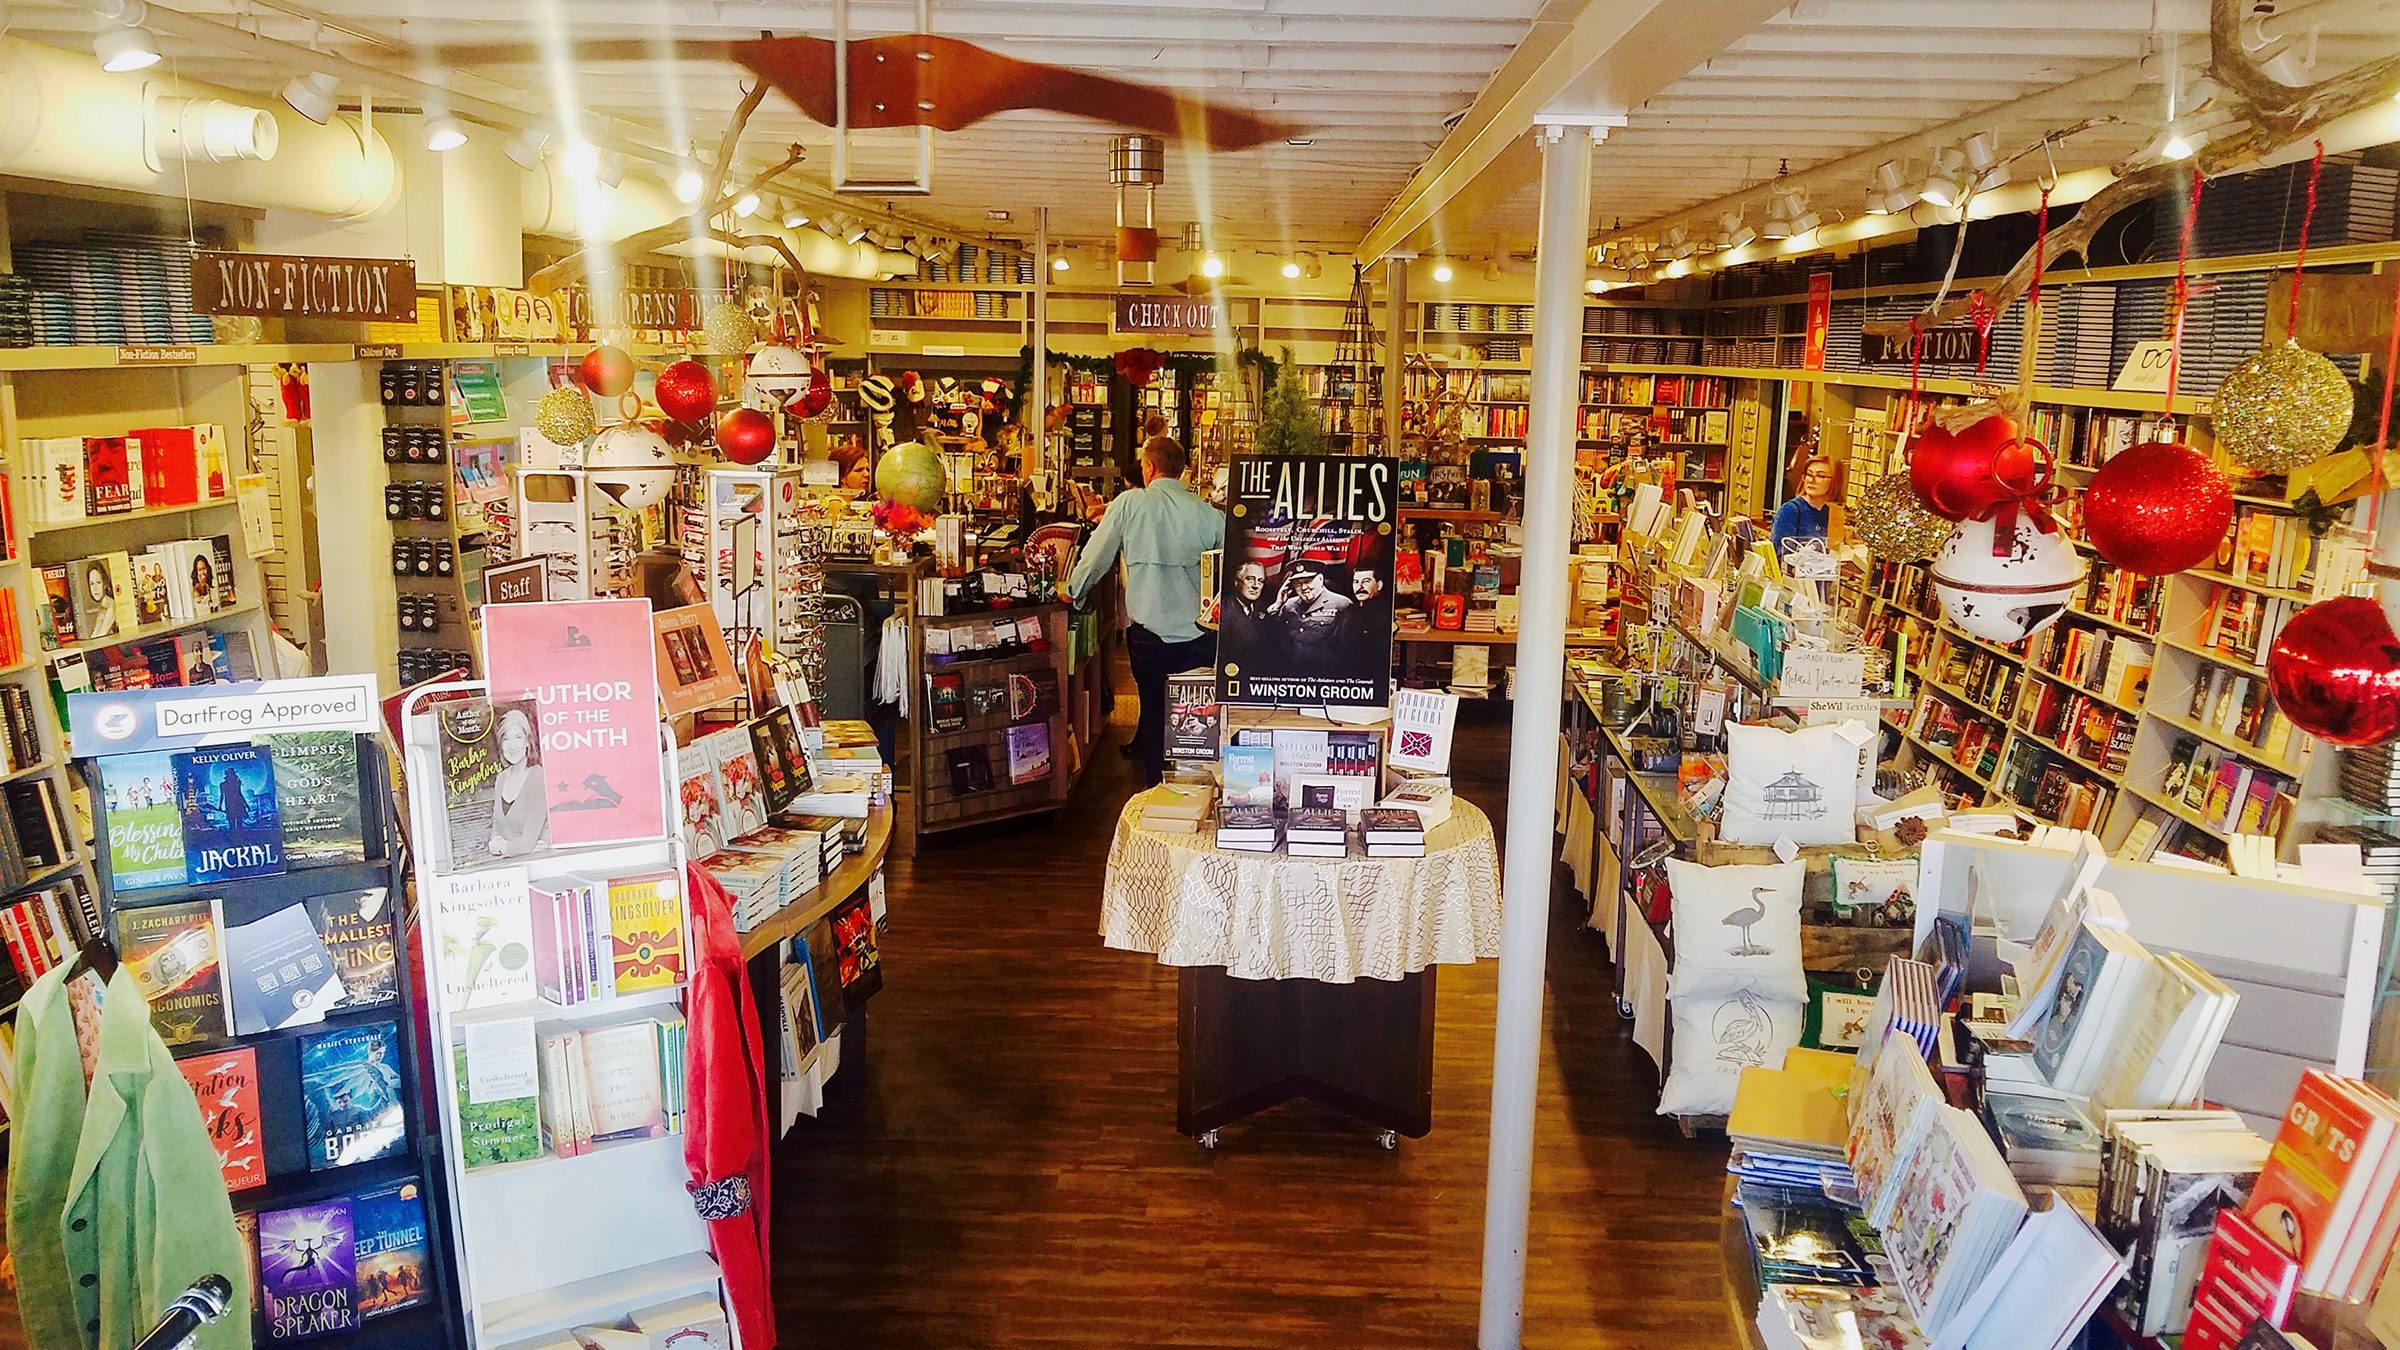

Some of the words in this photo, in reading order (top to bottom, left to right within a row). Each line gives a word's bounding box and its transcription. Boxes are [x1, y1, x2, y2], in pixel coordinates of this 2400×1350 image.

[219, 260, 389, 315] NON-FICTION
[119, 348, 159, 360] Non-Fiction
[160, 348, 196, 360] Bestsellers
[1400, 468, 1420, 479] FUN
[96, 484, 130, 500] FEAR
[1240, 461, 1273, 493] THE
[1273, 461, 1388, 522] ALLIES
[500, 577, 531, 600] Staff
[1168, 684, 1180, 696] THE
[1180, 685, 1216, 705] ALLIES
[1249, 683, 1317, 698] WINSTON
[1320, 685, 1374, 700] GROOM
[1400, 691, 1446, 711] SHROUDS
[1810, 701, 1843, 711] SheWil
[1844, 702, 1878, 711] Textiles
[164, 705, 252, 726] DartFrog
[260, 694, 357, 722] Approved
[456, 709, 481, 720] Author
[544, 710, 568, 726] OF
[577, 709, 611, 725] THE
[192, 753, 221, 765] KELLY
[221, 751, 257, 763] OLIVER
[271, 743, 346, 758] GLIMPSES
[1228, 753, 1255, 764] Forrest
[300, 762, 317, 773] OF
[286, 776, 333, 790] GOD'S
[285, 792, 338, 807] HEART
[1303, 808, 1342, 817] ALLIES
[121, 843, 141, 863] My
[196, 843, 280, 873] JACKAL
[449, 877, 511, 896] Barbara
[438, 893, 524, 915] Kingsolver
[614, 887, 653, 904] BARBARA
[79, 892, 101, 940] HITLER
[609, 899, 675, 922] KINGSOLVER
[140, 914, 187, 930] ZACHARY
[328, 912, 359, 928] THE
[446, 972, 530, 996] Unsheltered
[1836, 998, 1852, 1006] will
[470, 1115, 526, 1133] Prodigal
[471, 1133, 526, 1148] Summer
[353, 1237, 376, 1257] EEP
[378, 1226, 424, 1251] TUNNEL
[272, 1287, 348, 1318] DRAGON
[272, 1308, 353, 1339] SPEAKER
